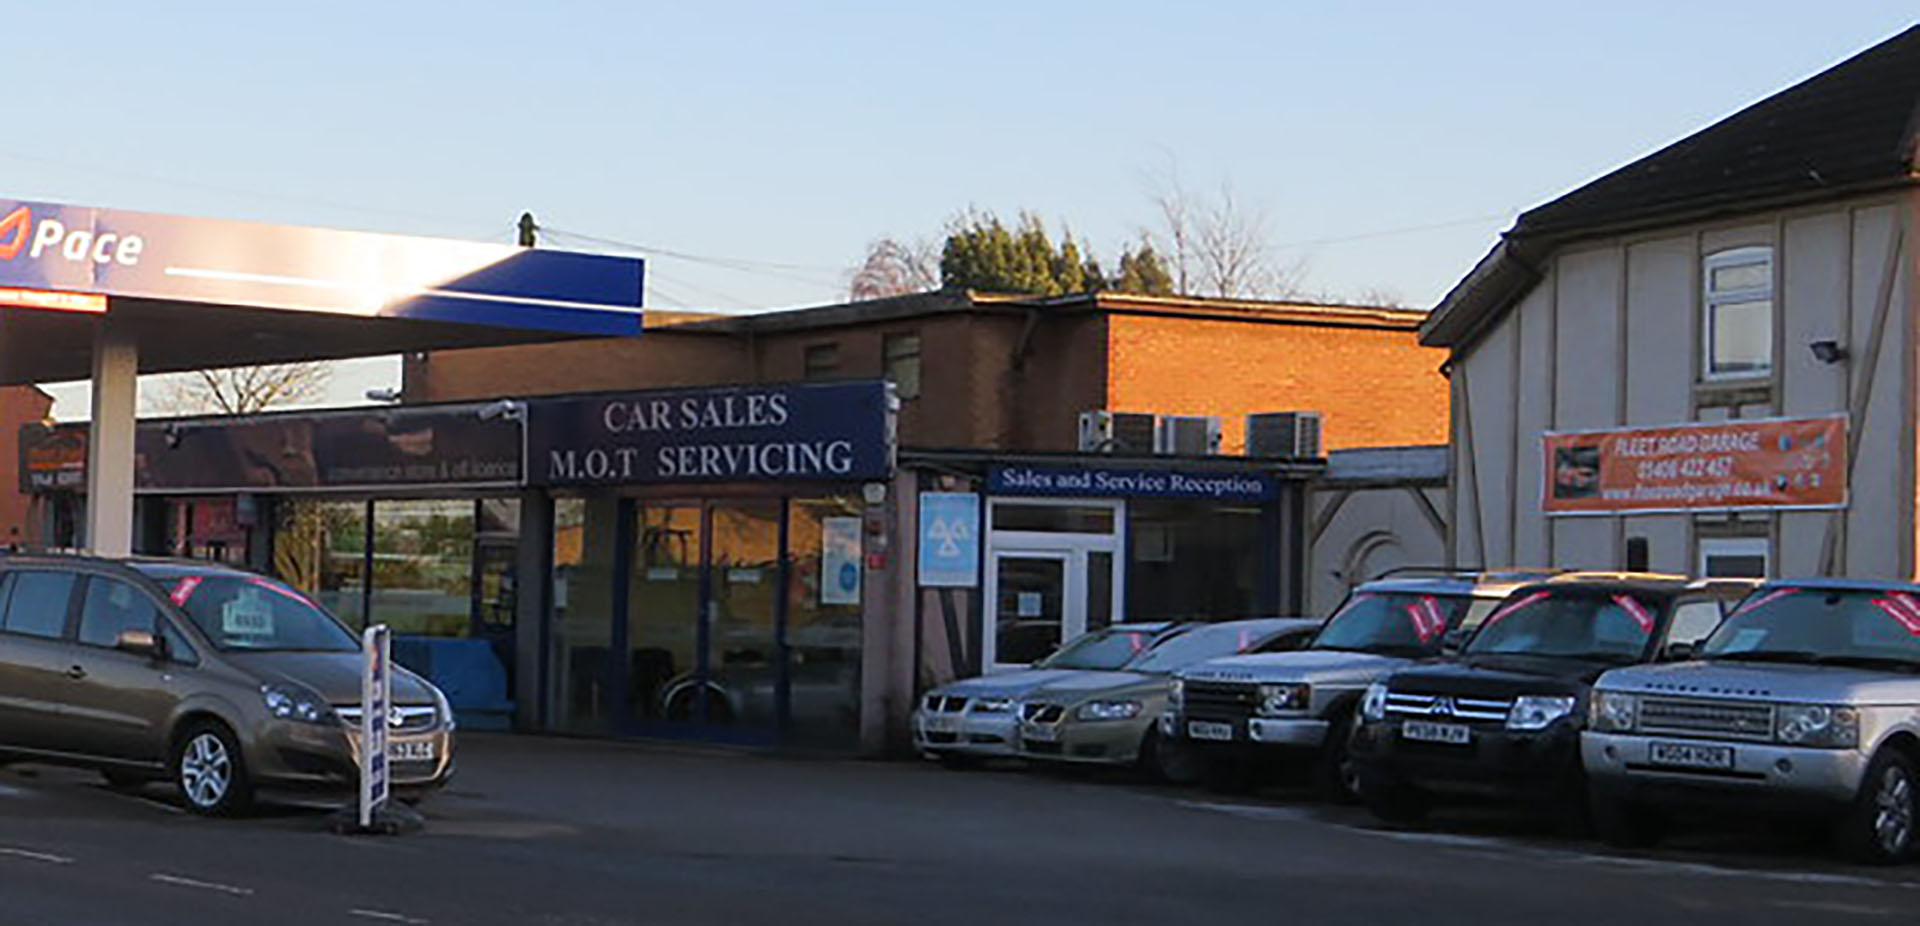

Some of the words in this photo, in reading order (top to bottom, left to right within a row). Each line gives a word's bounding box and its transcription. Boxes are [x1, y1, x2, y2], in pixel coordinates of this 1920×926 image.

[29, 218, 143, 265] Pace
[604, 401, 672, 432] CAR
[680, 394, 788, 428] SALES
[549, 449, 639, 479] M.O.T
[657, 440, 853, 477] SERVICING
[1614, 437, 1656, 456] FLEET
[1657, 435, 1698, 454] ROAD
[1699, 431, 1761, 452] GARAGE
[1001, 468, 1052, 488] Sales
[1056, 471, 1091, 488] and
[1095, 471, 1164, 491] Service
[1169, 474, 1264, 497] Reception
